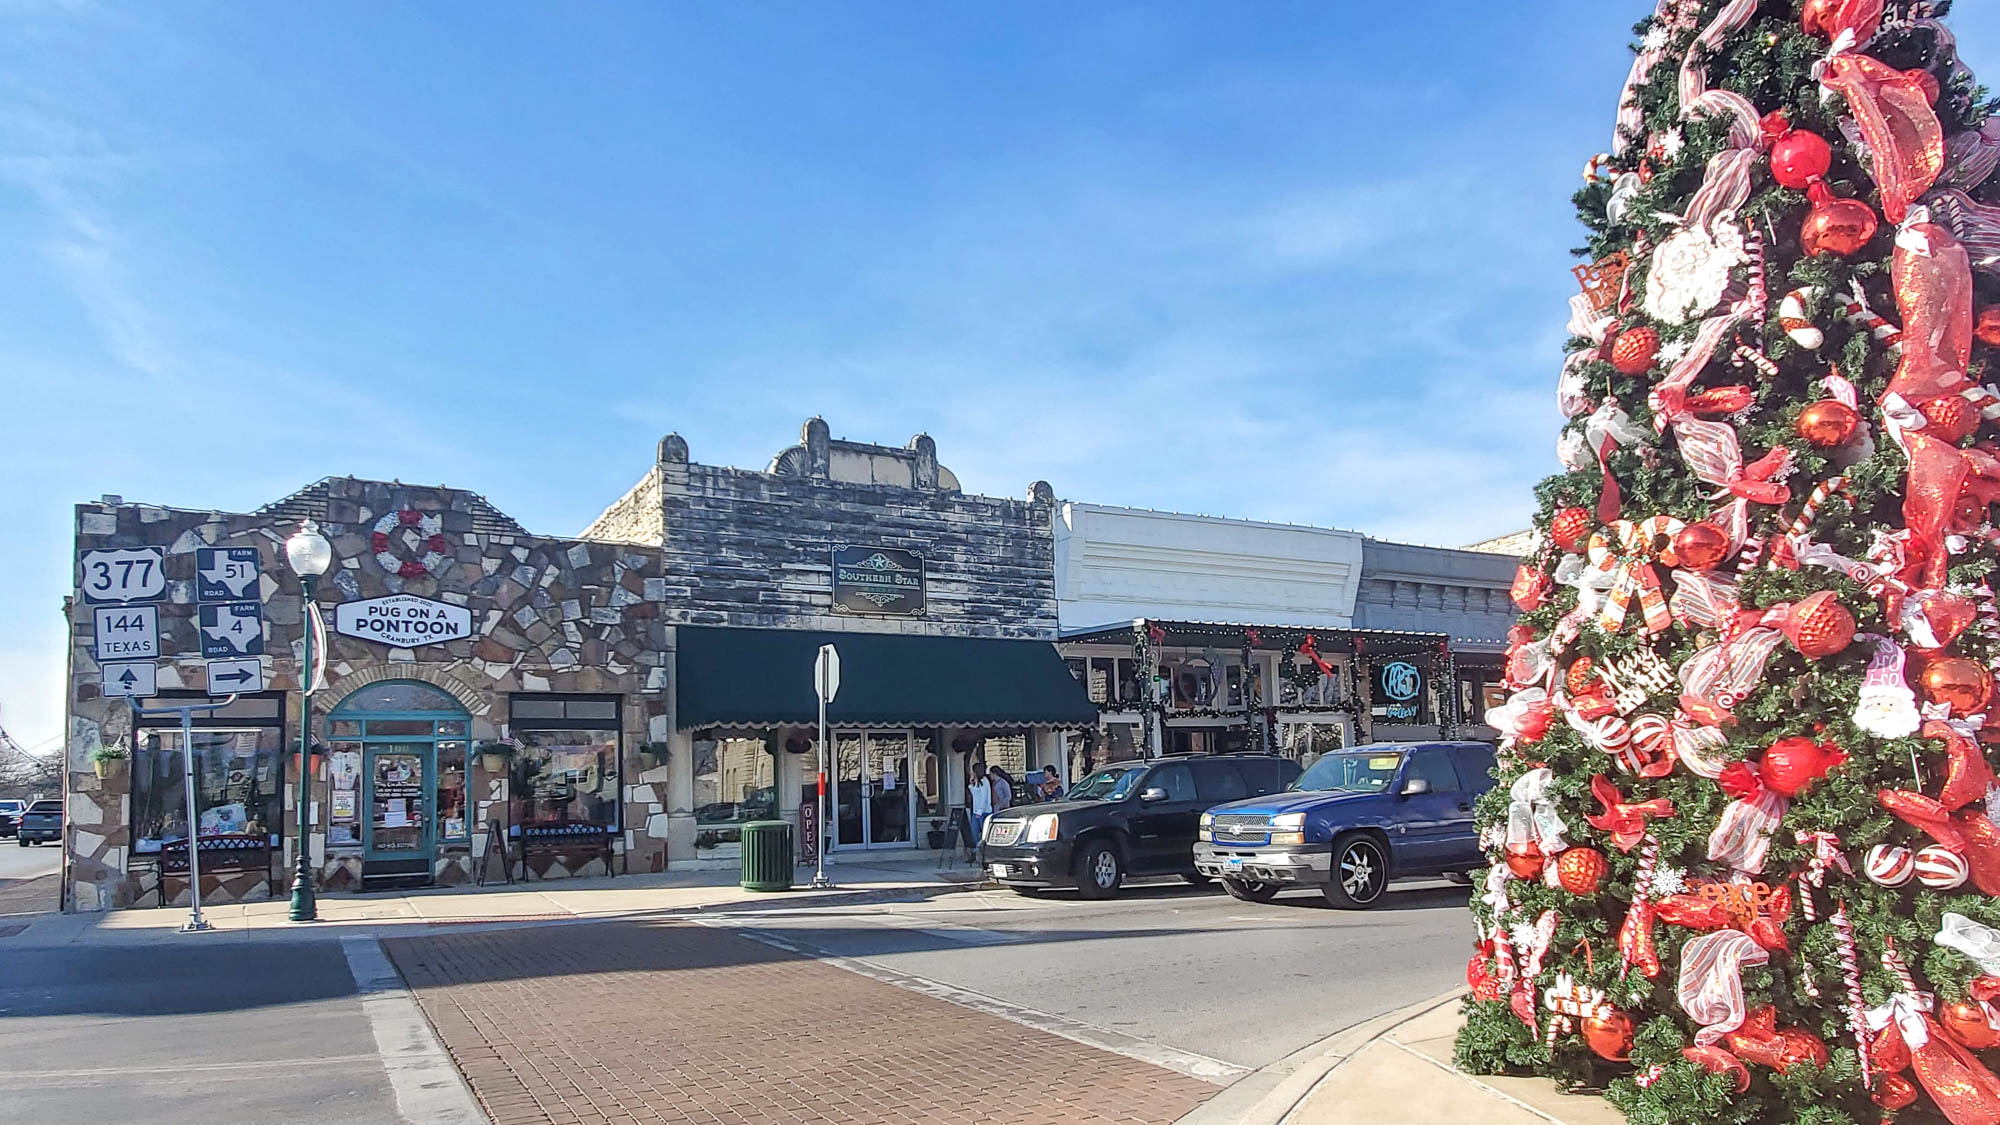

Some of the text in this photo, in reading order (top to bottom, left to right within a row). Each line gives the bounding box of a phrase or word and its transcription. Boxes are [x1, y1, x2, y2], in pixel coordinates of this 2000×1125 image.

[92, 559, 154, 591] 377
[226, 564, 245, 578] 51
[839, 568, 919, 585] SOUTHERN STAR
[368, 606, 447, 619] PUG ON A
[105, 614, 145, 633] 144
[231, 620, 243, 634] 4
[356, 618, 459, 635] PONTOON
[104, 640, 151, 653] TEXAS
[1593, 647, 1661, 699] Merry
[804, 807, 813, 853] OPEN
